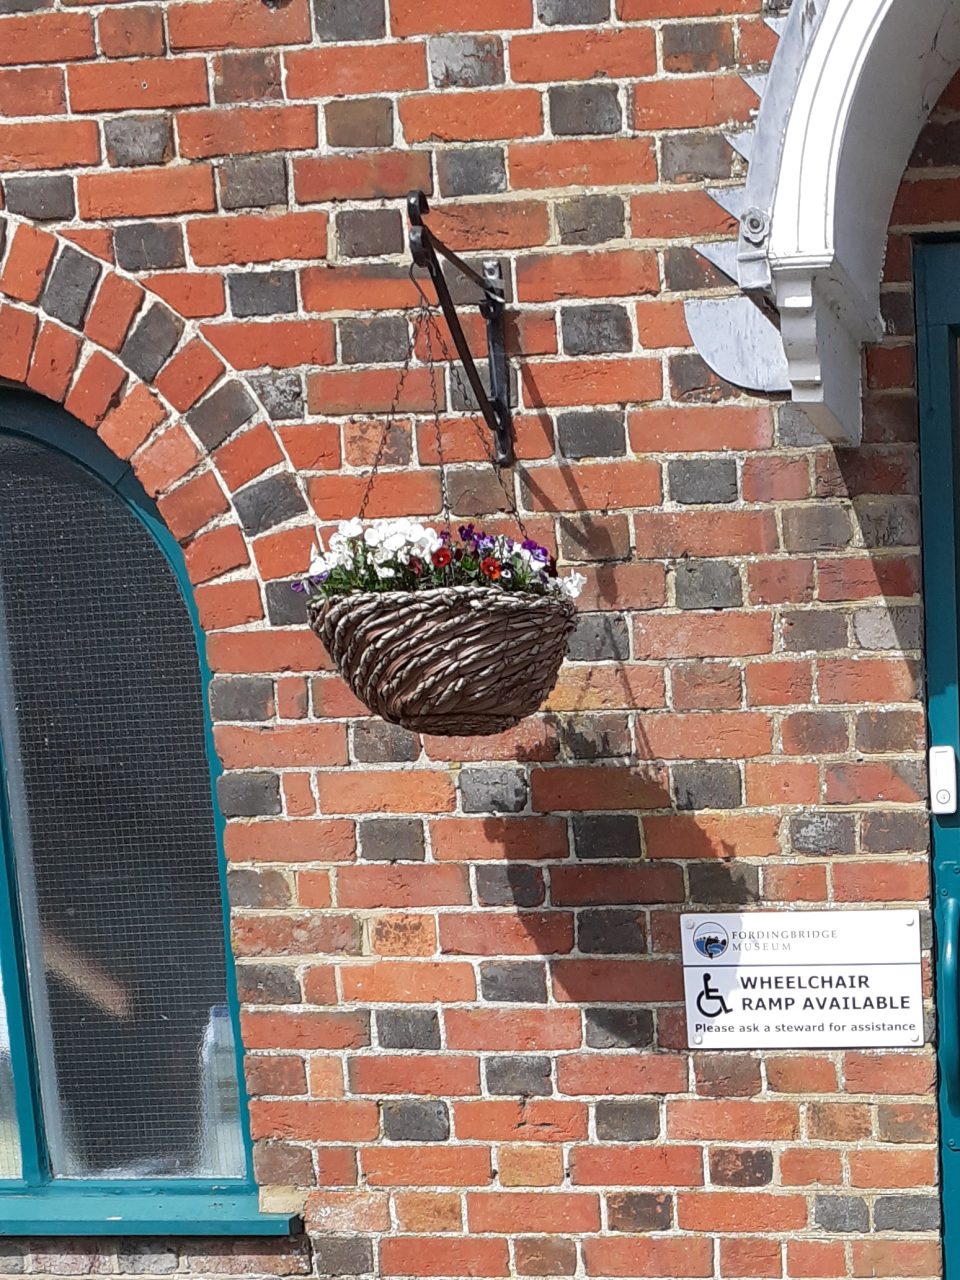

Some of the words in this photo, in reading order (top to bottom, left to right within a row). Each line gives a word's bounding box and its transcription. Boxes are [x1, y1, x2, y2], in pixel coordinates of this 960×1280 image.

[732, 930, 838, 940] FORDINGBRIDGE
[732, 942, 791, 952] MUSEUM
[740, 975, 870, 990] WHEELCHAIR
[742, 997, 795, 1011] RAMP
[803, 996, 911, 1011] AVAILABLE
[695, 1023, 735, 1033] Please
[739, 1022, 759, 1033] ask
[763, 1024, 771, 1032] a
[774, 1022, 825, 1033] steward
[829, 1021, 846, 1032] for
[850, 1021, 916, 1032] assistance
